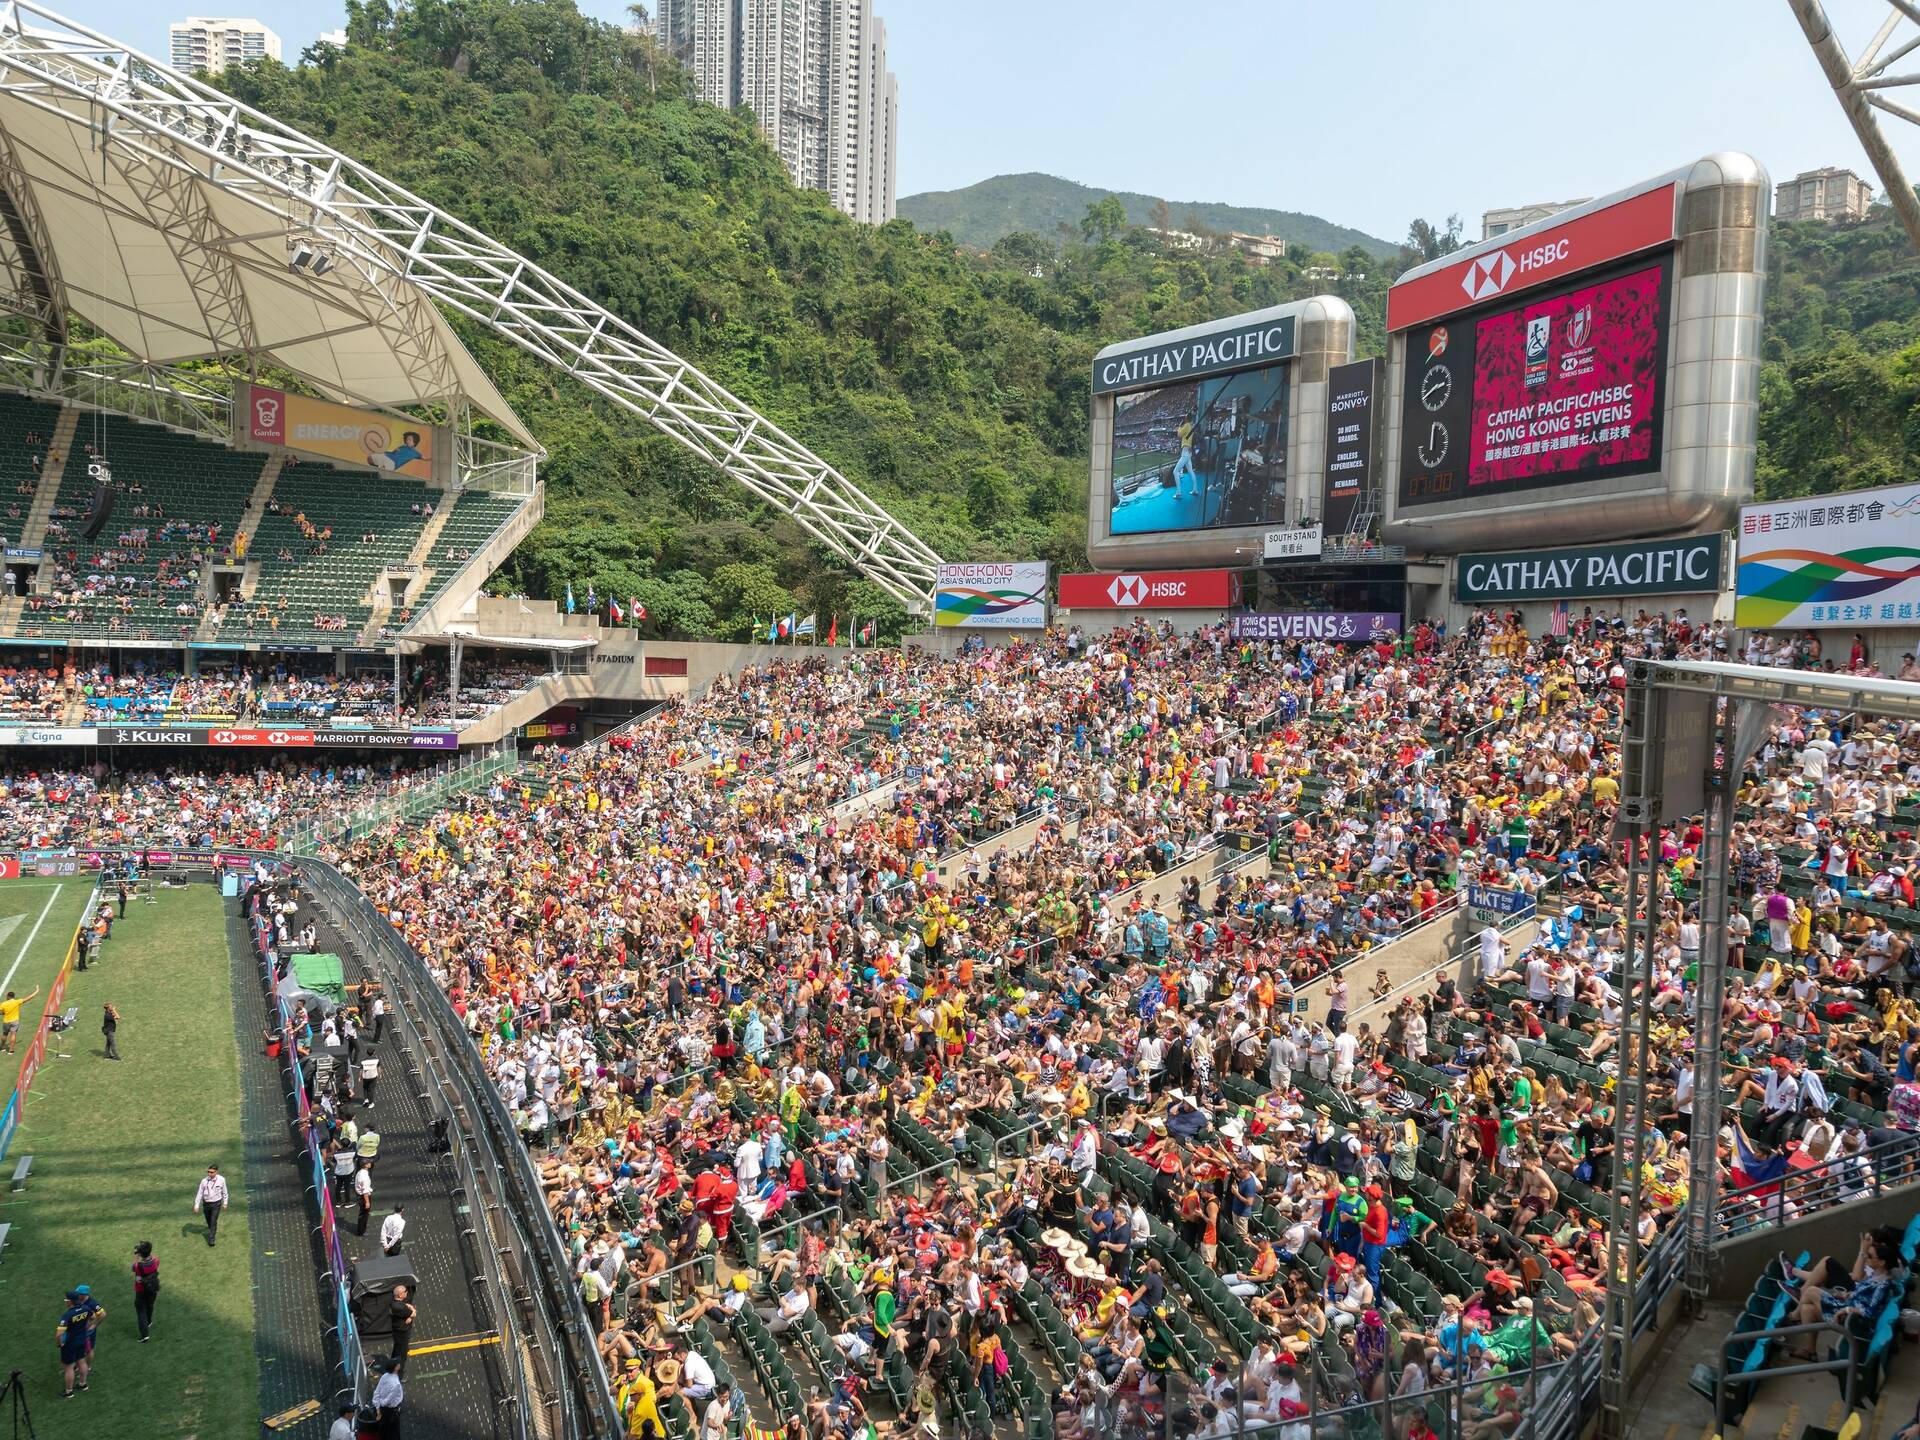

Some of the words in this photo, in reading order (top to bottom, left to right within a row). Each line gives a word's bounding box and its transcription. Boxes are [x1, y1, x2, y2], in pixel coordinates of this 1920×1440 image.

[1520, 239, 1569, 273] HSBC
[1103, 348, 1188, 385] CATHAY
[1191, 327, 1282, 369] PACIFIC
[1336, 390, 1364, 401] MARRIOTT
[1331, 396, 1368, 412] BONVOY
[1487, 405, 1535, 427] CATHAY
[1537, 384, 1633, 418] PACIFIC/HSBC
[1344, 424, 1360, 434] HOTEL
[1486, 426, 1526, 445] HONG
[1529, 416, 1570, 437] KONG
[1574, 404, 1632, 428] SEVENS
[254, 428, 280, 437] Garden
[295, 424, 362, 440] ENERGY
[1337, 451, 1358, 461] ENDLESS
[1334, 478, 1358, 489] REWARDS
[1268, 533, 1292, 543] SOUTH
[1294, 531, 1317, 540] STAND
[1280, 543, 1303, 554] 南看台
[940, 565, 974, 577] HONG
[976, 565, 1013, 577] KONG
[1466, 558, 1581, 591] CATHAY
[1587, 547, 1709, 587] PACIFIC
[1151, 582, 1186, 597] HSBC
[1812, 605, 1872, 621] 連繫全球
[972, 616, 1004, 624] CONNECT
[1005, 616, 1020, 624] AND
[1022, 616, 1043, 624] EXCEL
[1242, 616, 1258, 626] HONG
[1259, 616, 1338, 638] SEVENS
[597, 655, 635, 663] STADIUM
[32, 732, 62, 742] Cigna
[133, 731, 191, 742] KUKRI
[313, 734, 365, 743] MARRIOTT
[369, 735, 410, 744] BONVOY
[58, 862, 75, 872] 7:00
[1473, 888, 1500, 908] HKT
